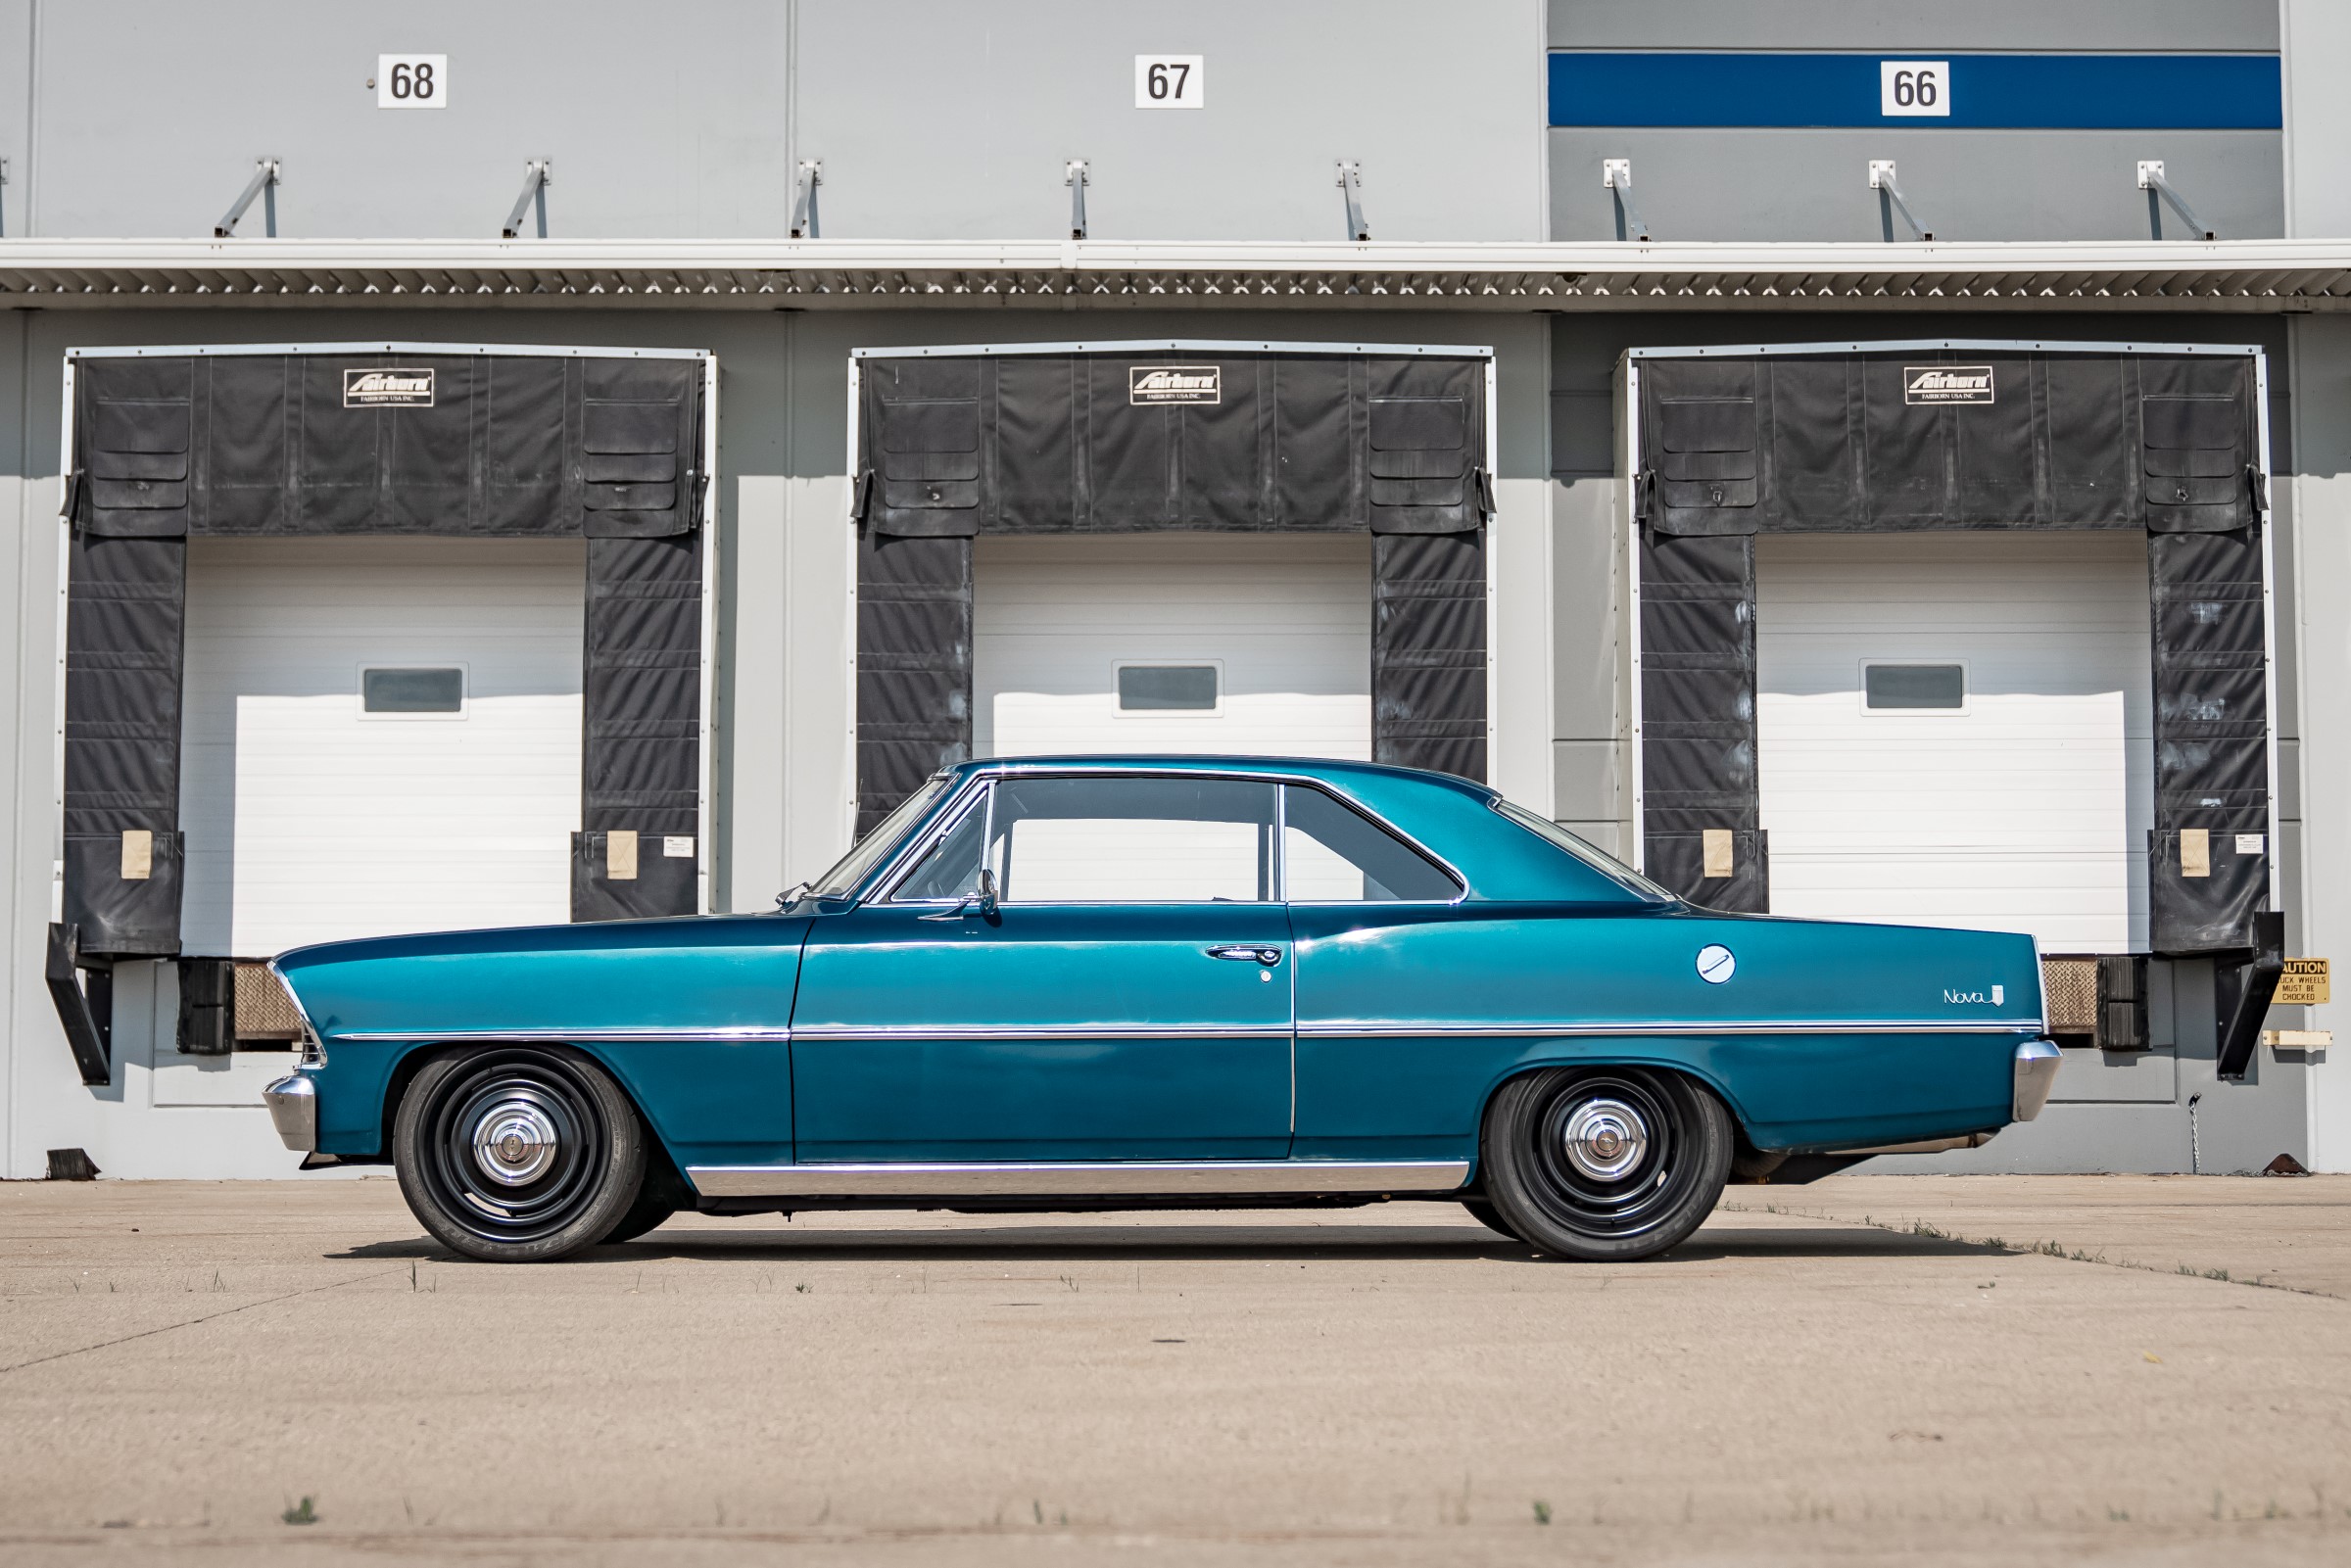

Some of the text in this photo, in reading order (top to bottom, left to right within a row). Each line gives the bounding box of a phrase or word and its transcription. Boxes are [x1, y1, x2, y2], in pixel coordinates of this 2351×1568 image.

[391, 63, 434, 99] 68
[1148, 64, 1190, 99] 67
[1895, 71, 1937, 107] 66
[1909, 371, 1988, 389] Fairborn
[2282, 962, 2327, 974] AUTION
[1943, 988, 1992, 1003] Nova
